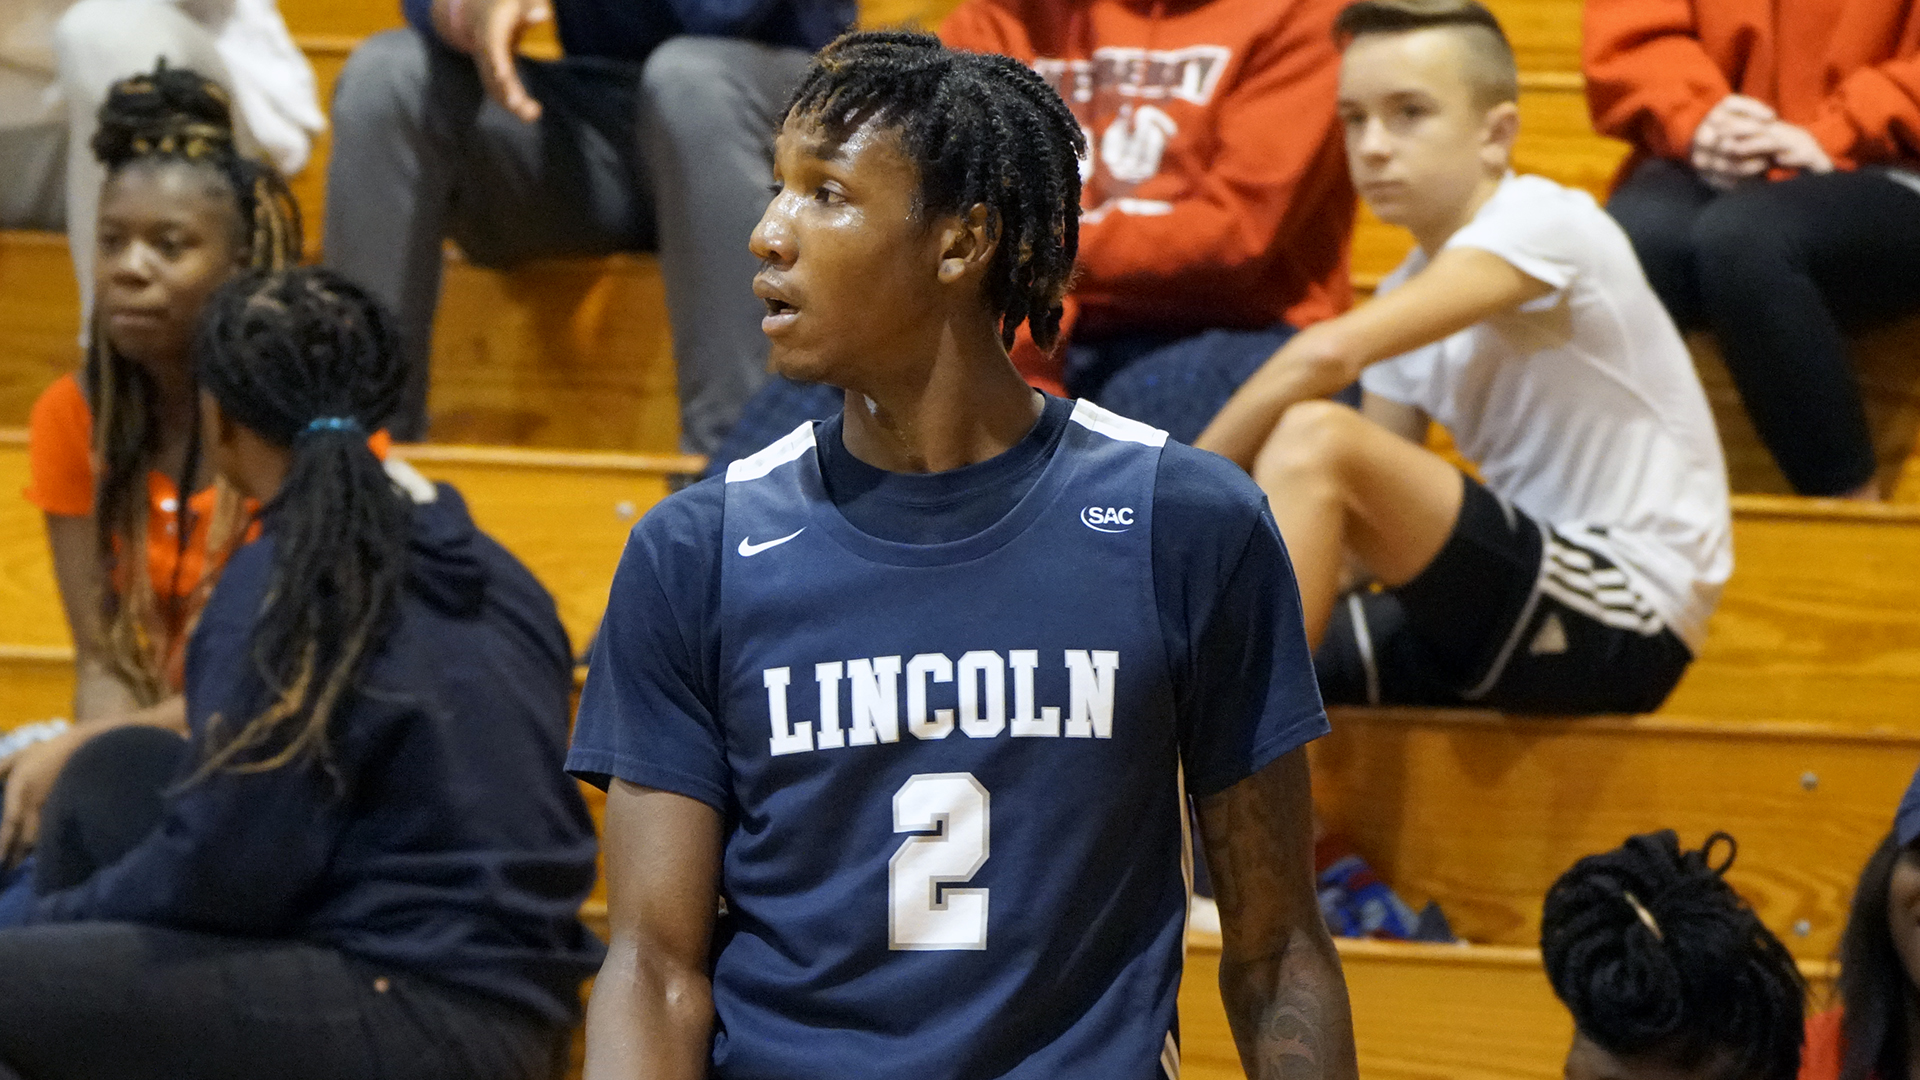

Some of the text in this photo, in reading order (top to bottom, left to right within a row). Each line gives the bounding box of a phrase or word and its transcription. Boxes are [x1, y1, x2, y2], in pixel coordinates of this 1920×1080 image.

[1088, 506, 1134, 525] SAC
[763, 649, 1120, 756] LINCOLN
[888, 772, 990, 951] 2
